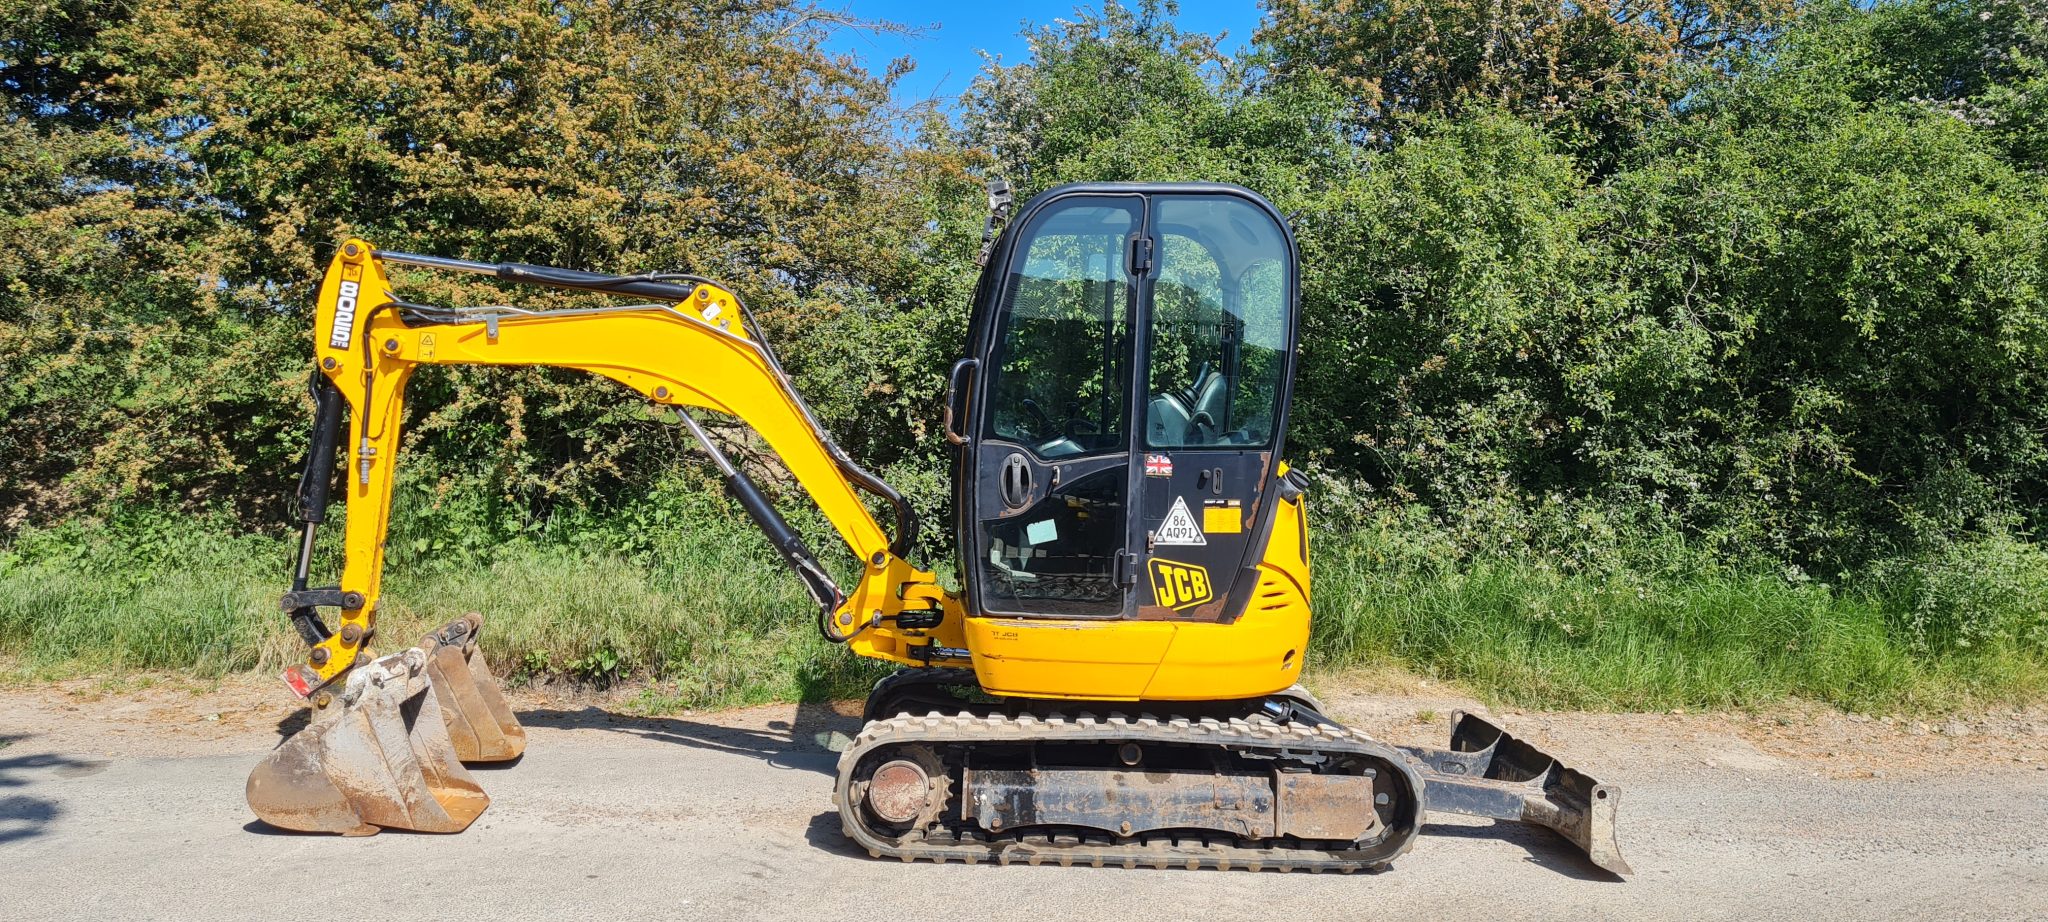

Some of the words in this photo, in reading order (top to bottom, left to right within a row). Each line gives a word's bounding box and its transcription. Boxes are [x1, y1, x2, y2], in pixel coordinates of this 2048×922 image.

[332, 281, 359, 342] 8025
[1173, 515, 1186, 526] 86
[1158, 564, 1207, 607] JCB
